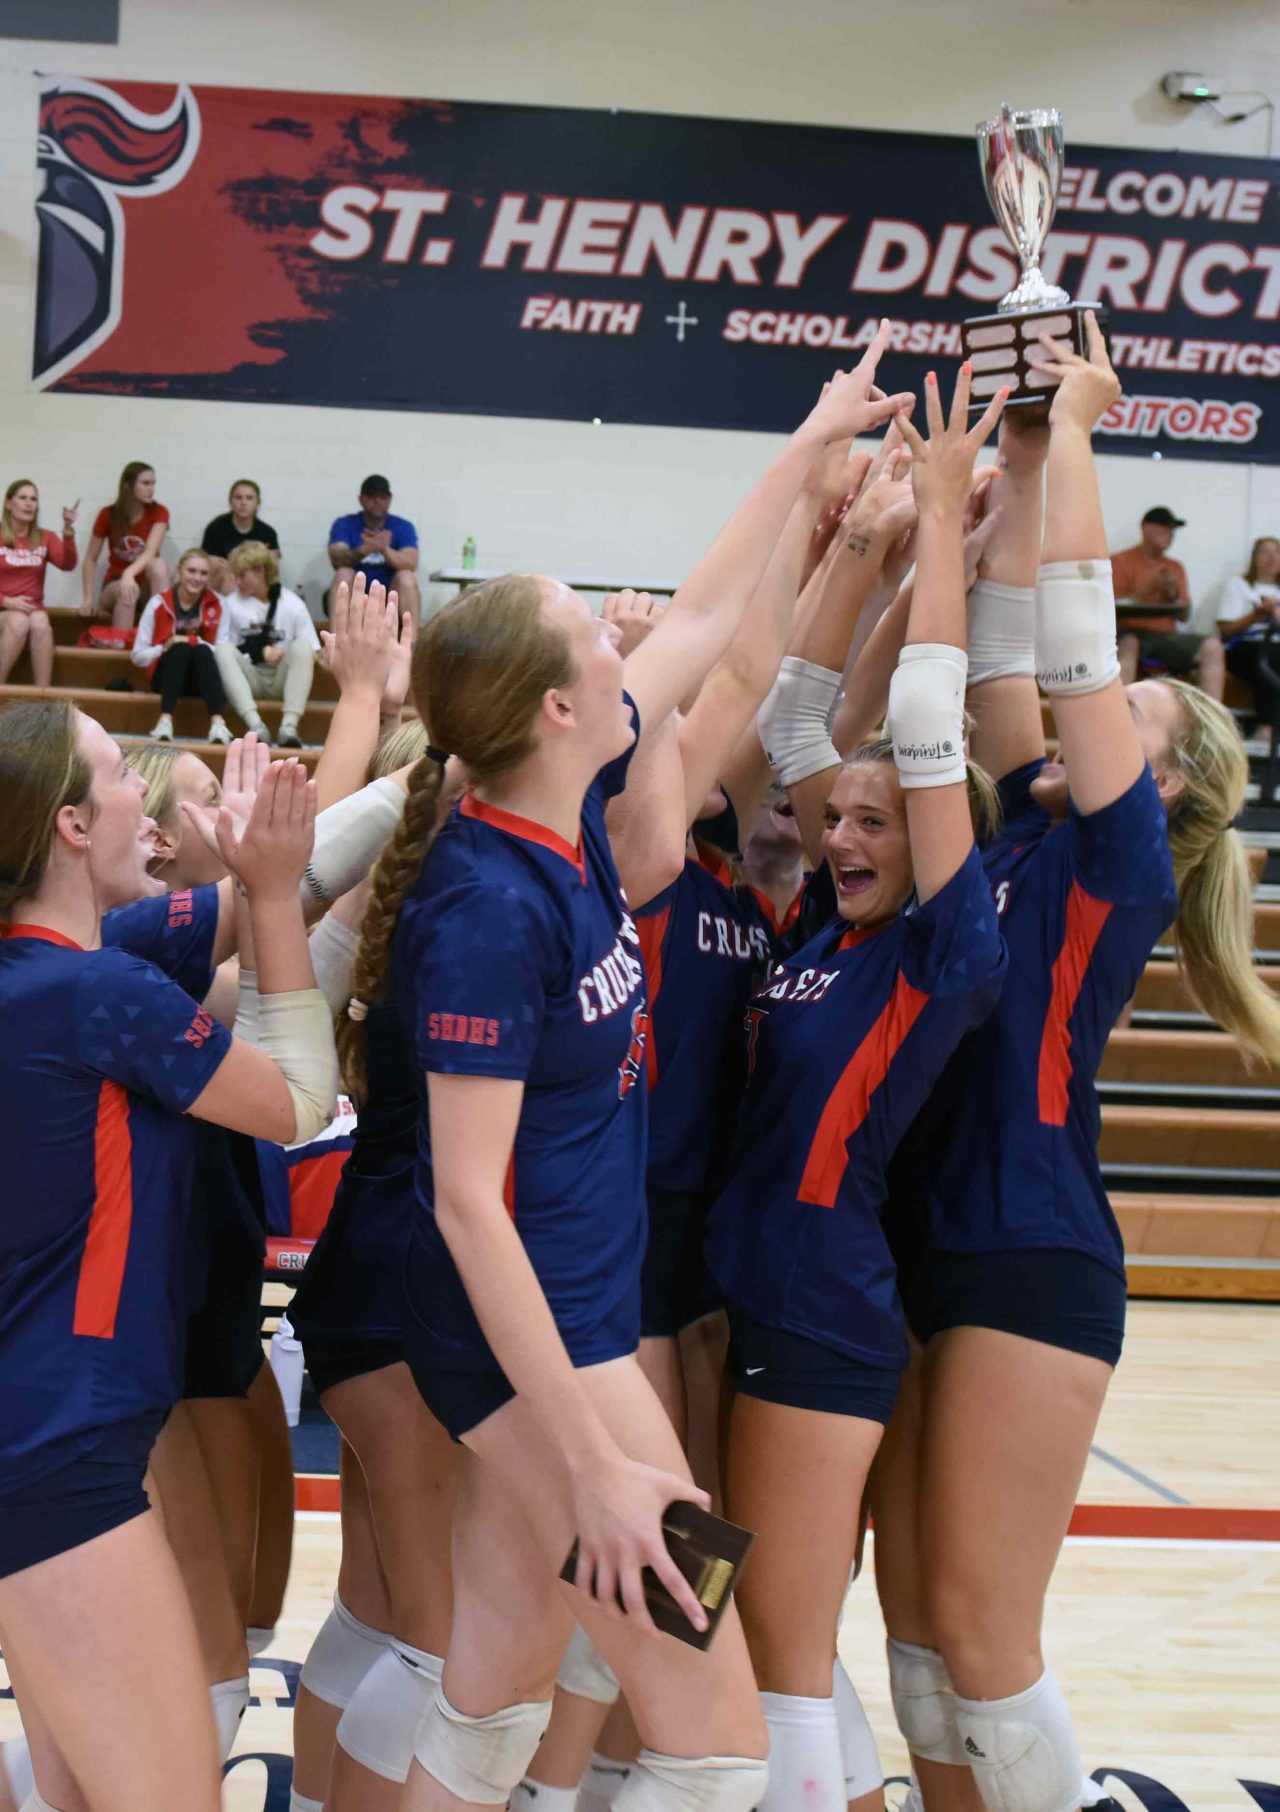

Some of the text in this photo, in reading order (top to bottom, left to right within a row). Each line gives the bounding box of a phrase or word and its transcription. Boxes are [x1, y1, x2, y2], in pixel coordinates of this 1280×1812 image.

[1056, 166, 1269, 223] ELCOME
[310, 185, 1280, 321] ST. HENRY DISTRICT
[521, 297, 1280, 378] FAITH SCHOLARSH THLETICS
[1100, 395, 1262, 444] SITORS
[427, 1012, 500, 1047] SHDHS
